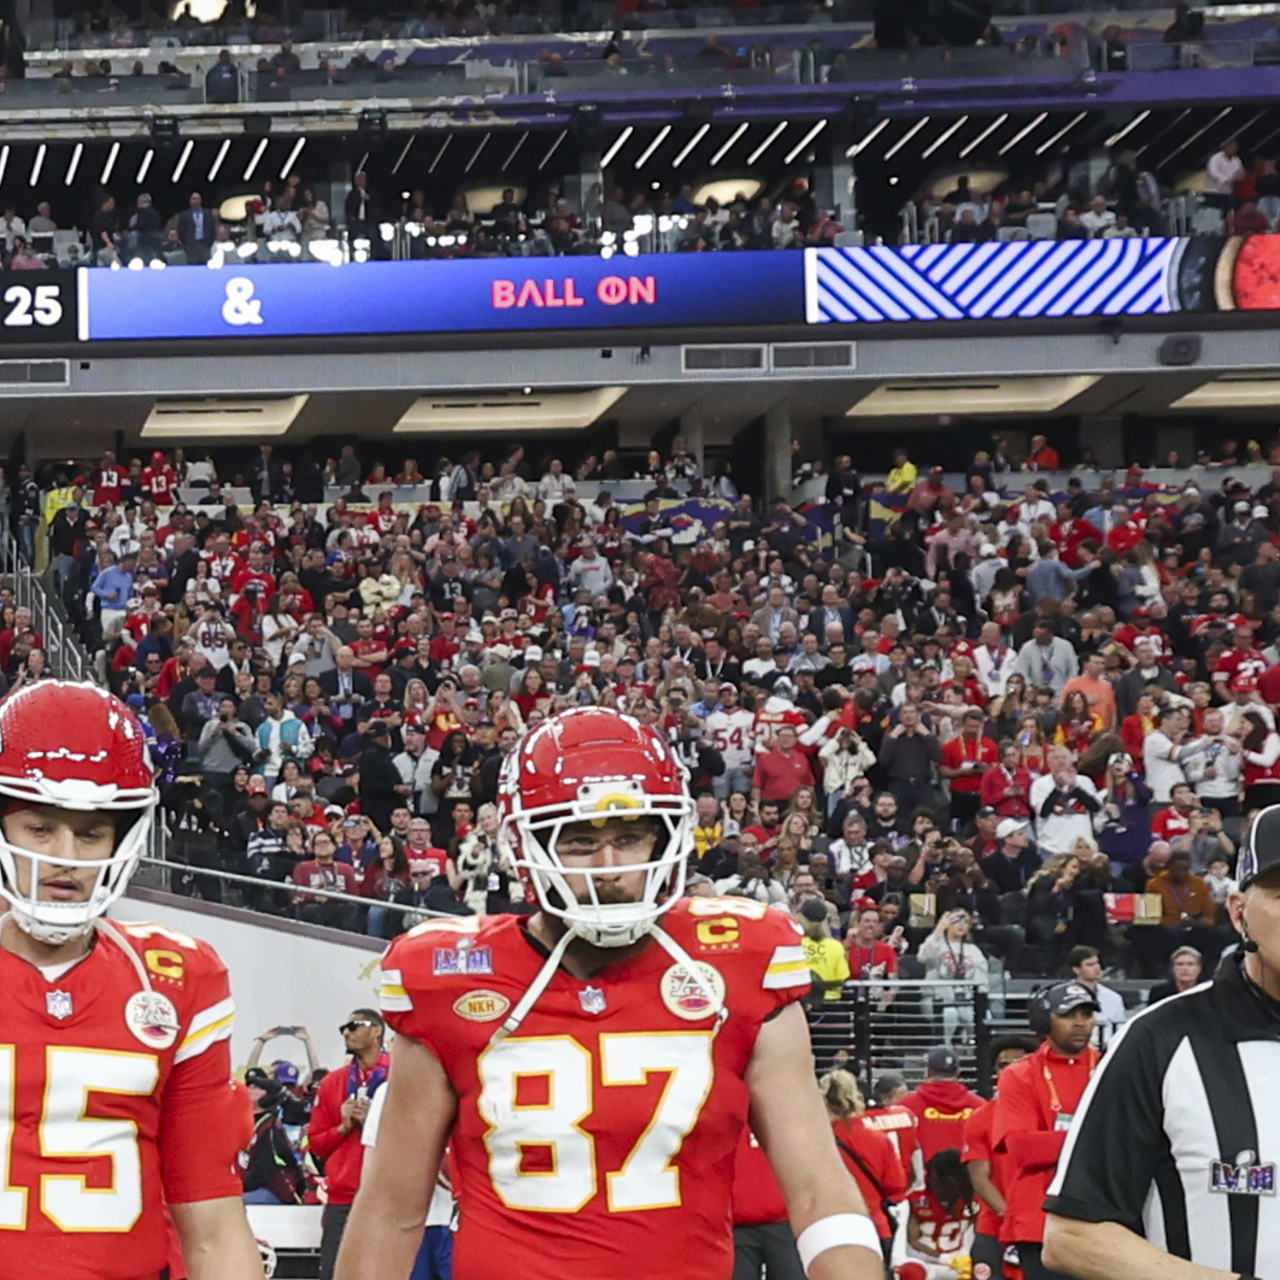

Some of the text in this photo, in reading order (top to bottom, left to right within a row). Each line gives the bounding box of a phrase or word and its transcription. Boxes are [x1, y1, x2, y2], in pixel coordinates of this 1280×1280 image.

[3, 284, 63, 327] 25
[221, 276, 265, 325] &
[492, 276, 657, 310] BALL ON
[101, 472, 120, 487] 13
[151, 477, 168, 493] 13
[443, 583, 462, 599] 13
[713, 727, 744, 751] 54
[696, 916, 741, 945] C
[144, 948, 185, 980] C
[467, 998, 496, 1014] NKH
[477, 1029, 715, 1214] 87
[918, 1220, 968, 1252] 10
